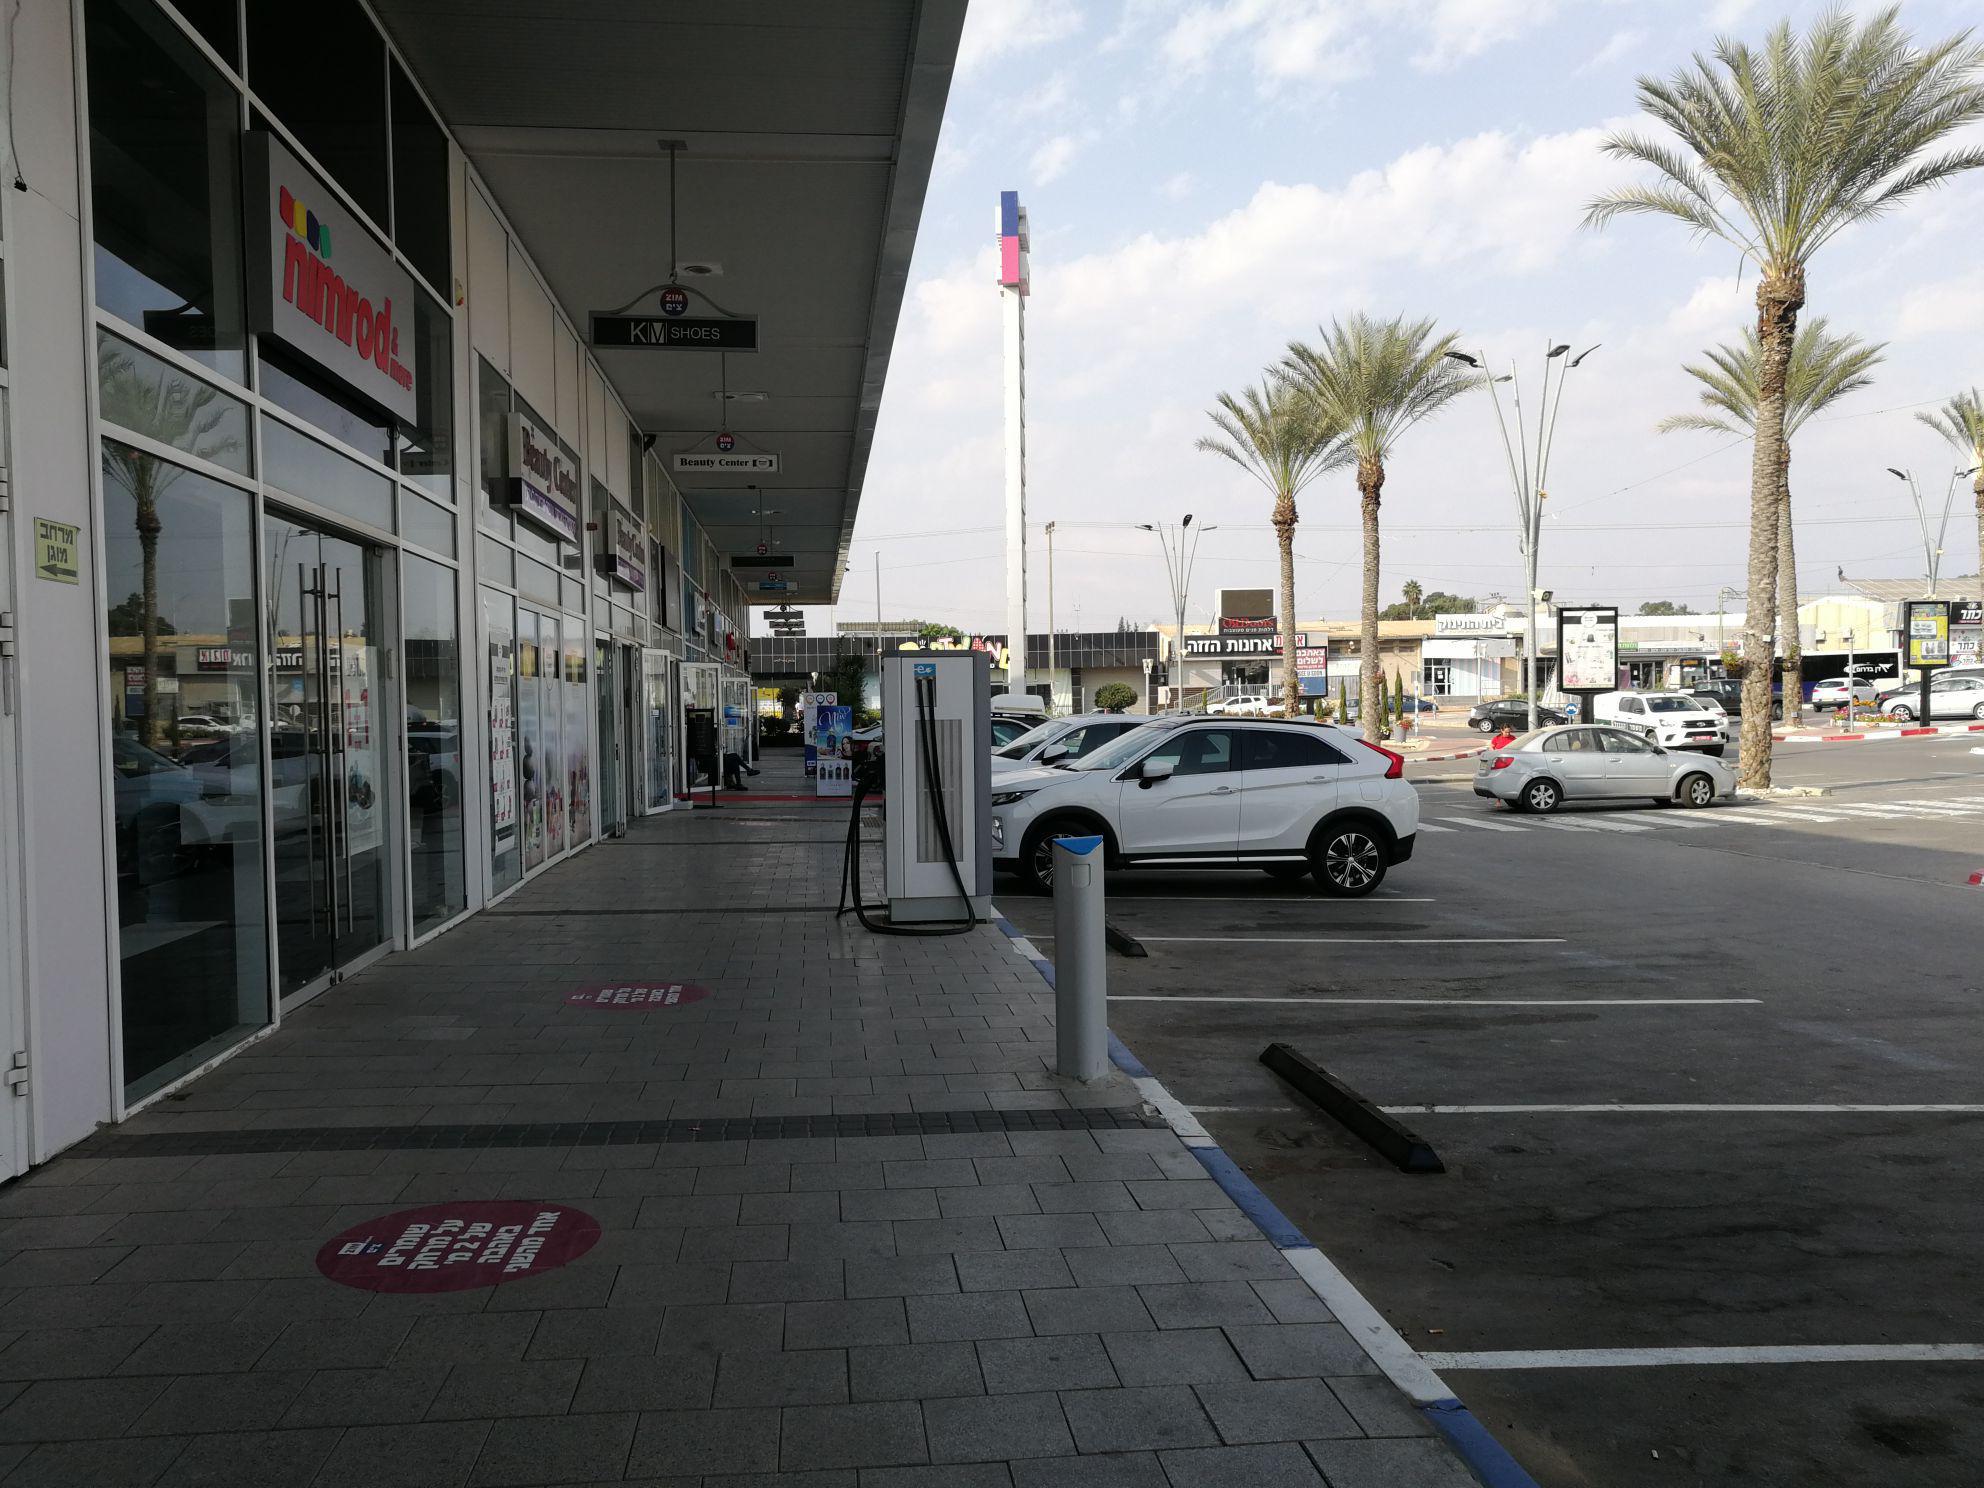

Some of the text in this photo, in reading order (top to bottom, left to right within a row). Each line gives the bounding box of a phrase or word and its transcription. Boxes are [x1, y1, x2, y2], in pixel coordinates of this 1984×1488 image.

[282, 232, 392, 376] nimrod
[670, 327, 720, 340] SHOES
[390, 357, 413, 391] more
[679, 458, 716, 468] Beauty
[718, 458, 750, 467] Center
[40, 522, 74, 546] מרחב
[47, 544, 68, 564] מוגן
[1960, 609, 1983, 620] כתר
[1187, 640, 1221, 653] הזזה
[1226, 639, 1273, 653] ארונות
[1957, 642, 1975, 651] כתר
[1297, 656, 1324, 665] לשלום
[457, 1222, 493, 1240] של
[377, 1224, 424, 1266] שומרים
[406, 1219, 465, 1270] על מרחק
[452, 1241, 481, 1251] 2
[476, 1225, 524, 1264] באהבה
[503, 1211, 561, 1273] אחד מהשני
